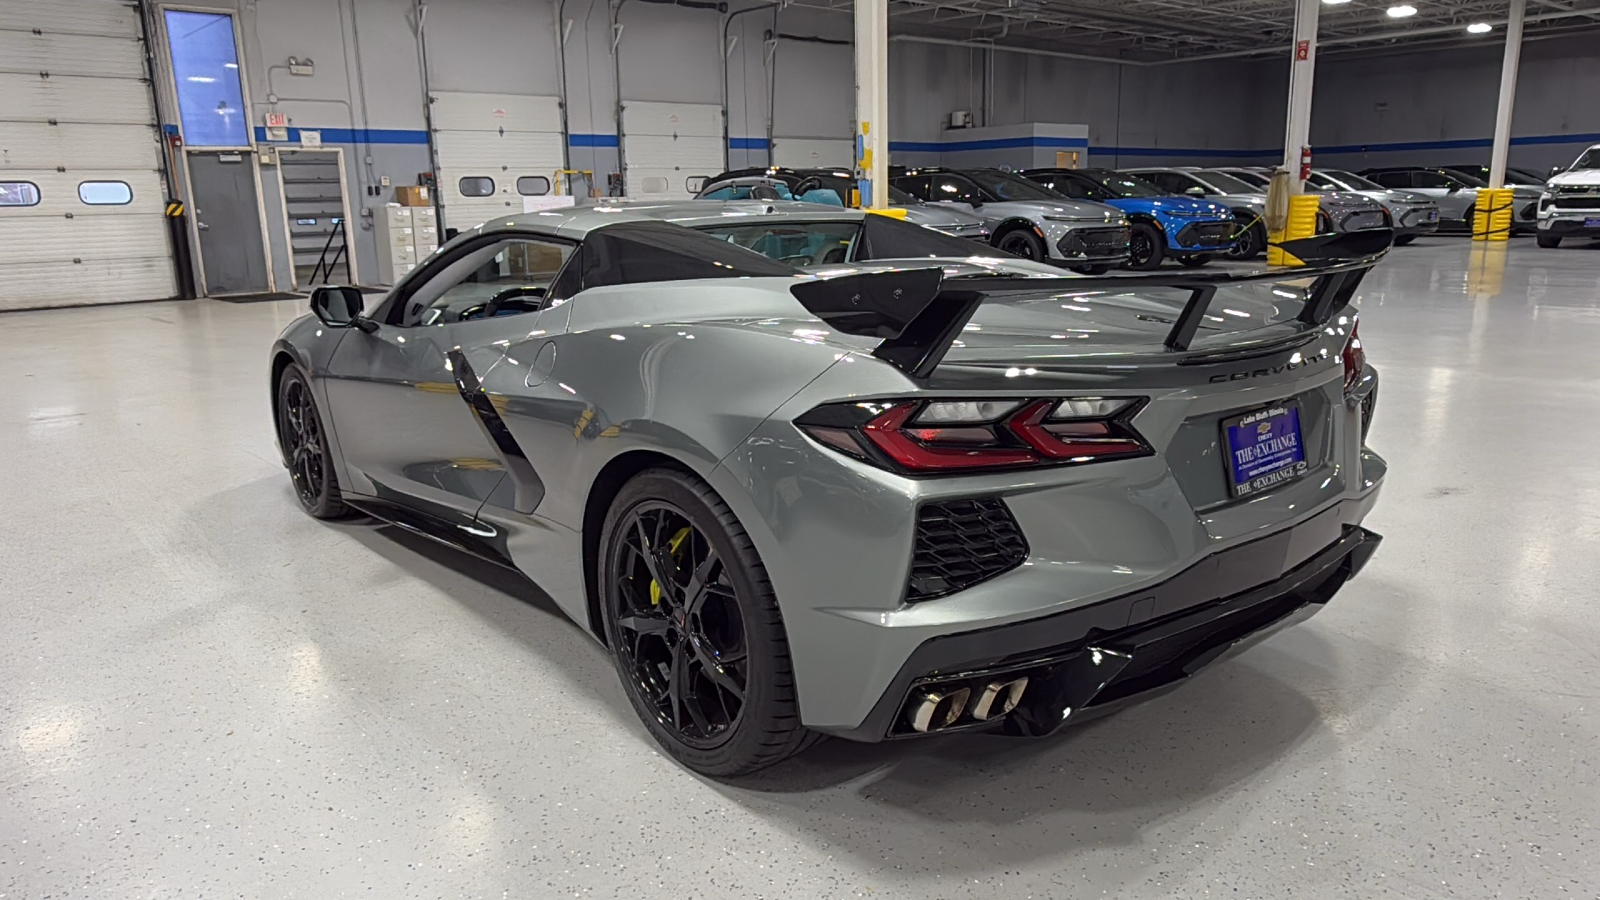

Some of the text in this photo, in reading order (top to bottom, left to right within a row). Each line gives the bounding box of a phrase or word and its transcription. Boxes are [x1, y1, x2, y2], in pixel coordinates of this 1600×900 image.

[269, 113, 285, 126] EXIT
[1243, 415, 1256, 424] Lake
[1257, 433, 1273, 442] CHEVY
[1235, 433, 1297, 464] THE EXCHANGE
[1236, 466, 1295, 496] THE EXCHANGE
